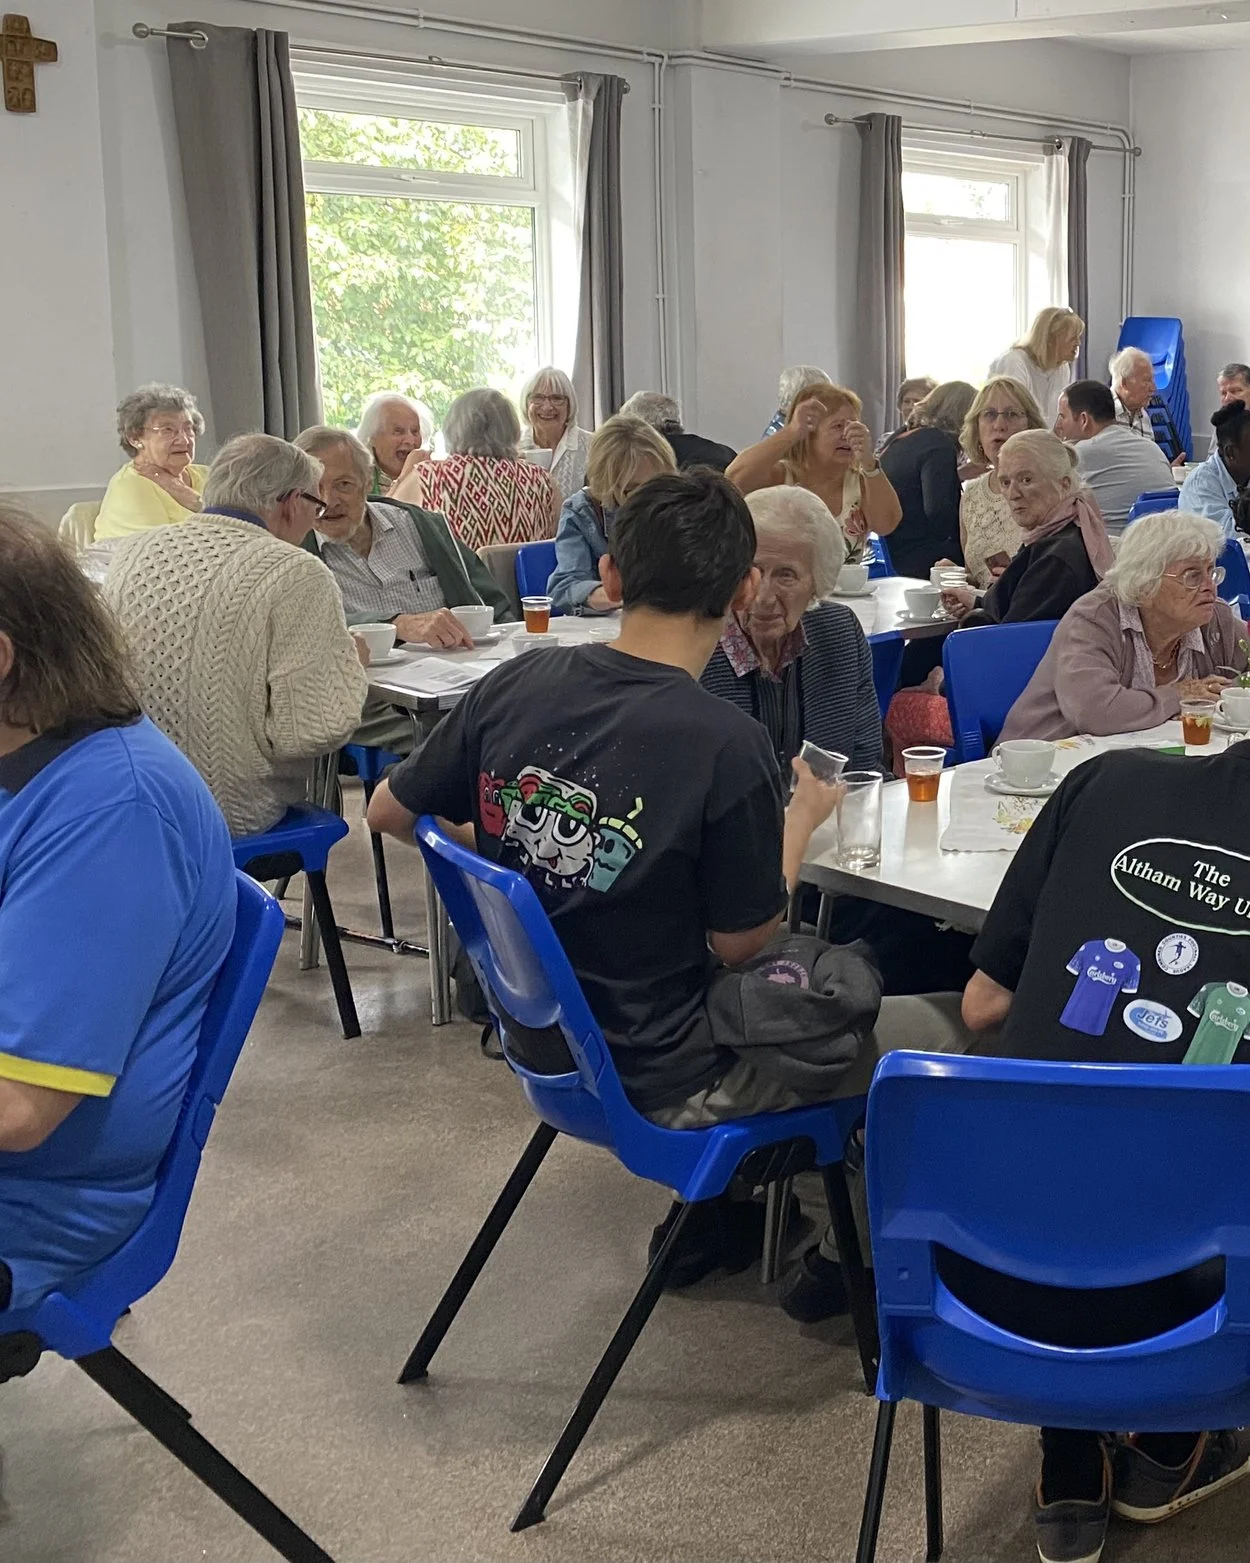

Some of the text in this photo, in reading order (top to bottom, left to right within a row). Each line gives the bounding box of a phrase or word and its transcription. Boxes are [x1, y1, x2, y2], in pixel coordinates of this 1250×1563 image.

[1114, 855, 1182, 892] Altham
[1189, 881, 1231, 911] Way
[1193, 860, 1231, 887] The
[1087, 966, 1117, 985] Carlsberg
[1137, 1009, 1169, 1029] Jets
[1209, 1009, 1239, 1032] Carlsberg
